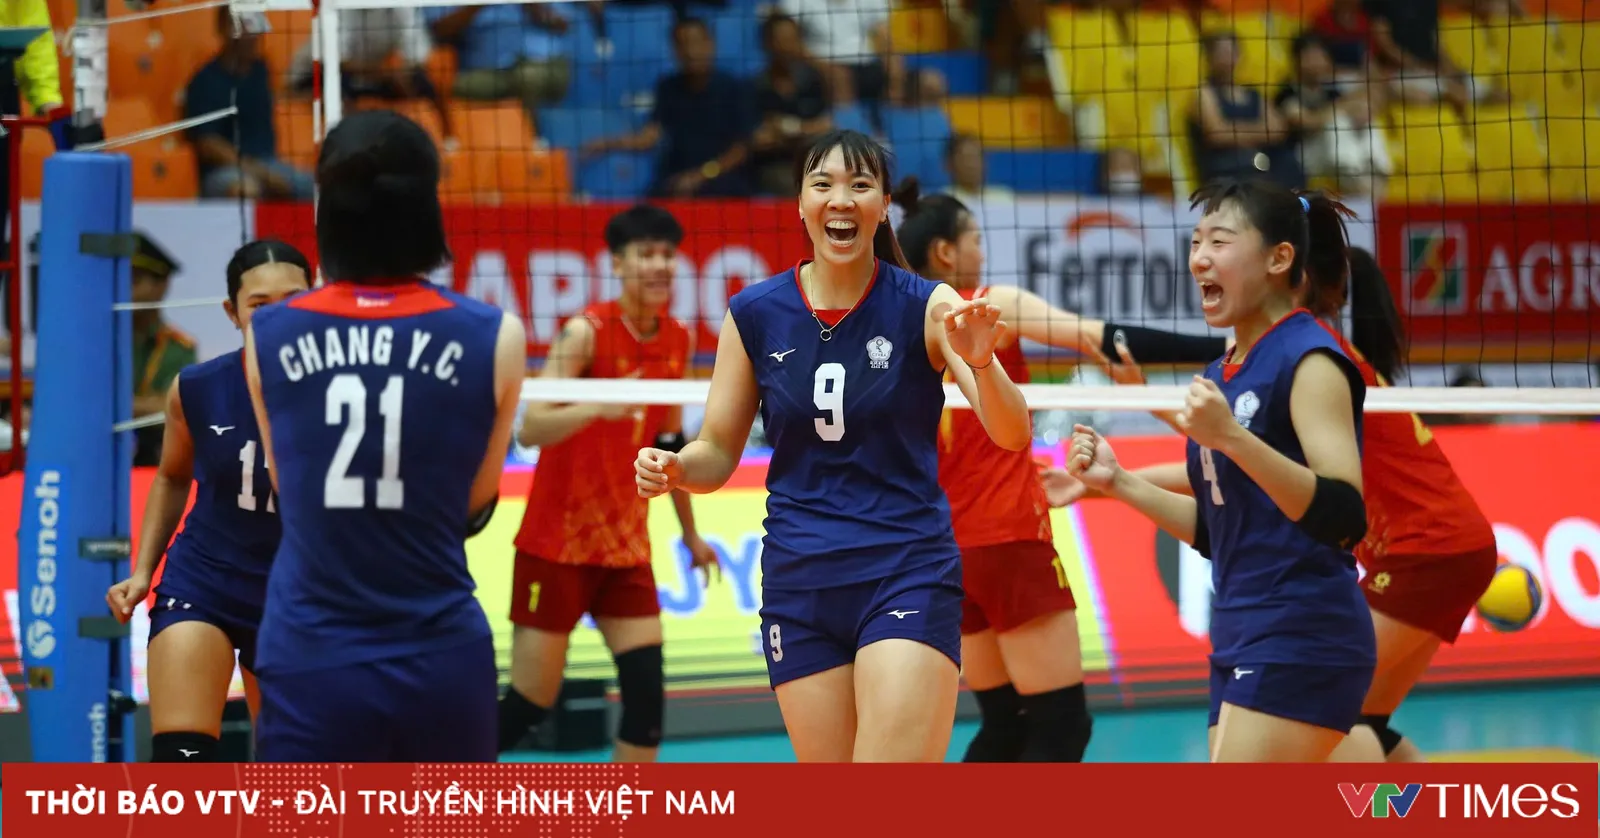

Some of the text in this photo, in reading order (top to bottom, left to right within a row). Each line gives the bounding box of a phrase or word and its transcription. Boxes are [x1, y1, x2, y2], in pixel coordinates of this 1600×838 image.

[278, 325, 464, 386] CHANG Y.C.
[813, 363, 846, 441] 9
[324, 374, 404, 509] 21
[31, 470, 60, 616] Senoh
[528, 581, 541, 612] 1
[769, 624, 783, 662] 9
